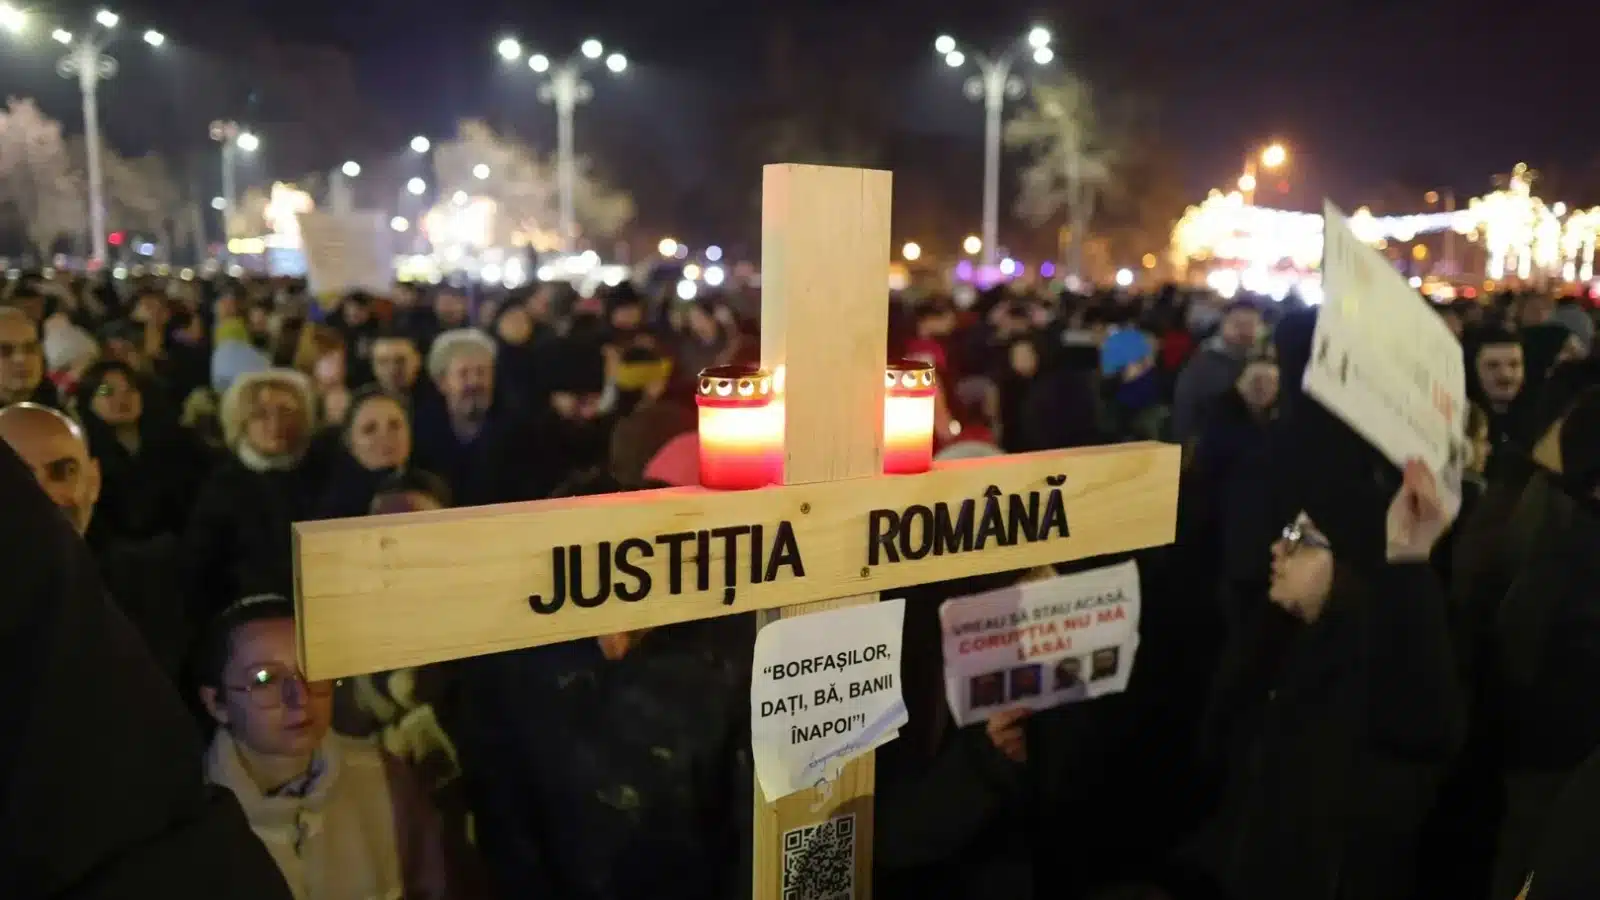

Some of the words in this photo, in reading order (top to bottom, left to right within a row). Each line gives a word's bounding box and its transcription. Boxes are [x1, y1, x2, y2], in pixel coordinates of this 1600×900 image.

[529, 521, 806, 615] JUSTIȚIA
[868, 474, 1070, 565] ROMÂNĂ
[1064, 613, 1091, 630] NU
[761, 694, 808, 718] DAȚI,
[814, 682, 843, 707] BĂ,
[849, 673, 893, 699] BANII
